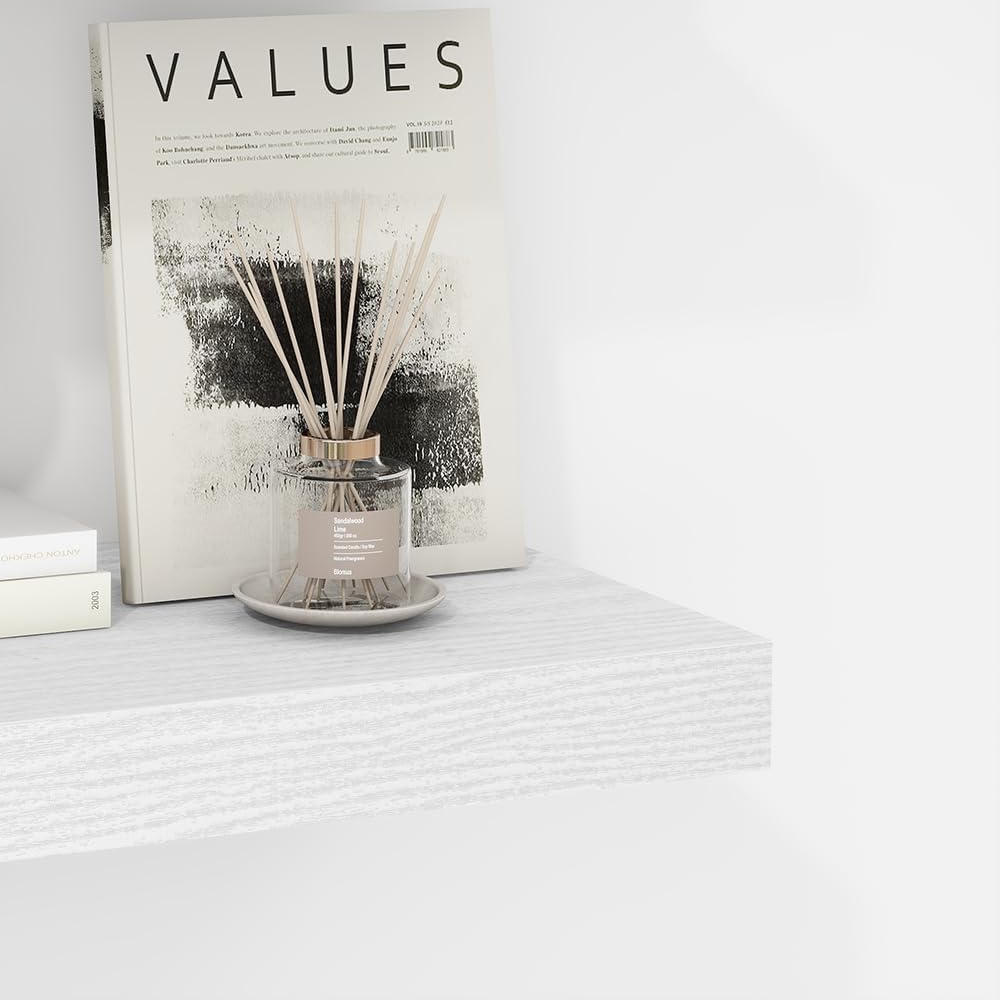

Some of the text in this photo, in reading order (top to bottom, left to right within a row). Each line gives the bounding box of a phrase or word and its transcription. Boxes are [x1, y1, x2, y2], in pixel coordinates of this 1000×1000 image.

[146, 40, 463, 102] VALUES
[49, 549, 80, 559] ANTON
[91, 590, 100, 610] 2003
